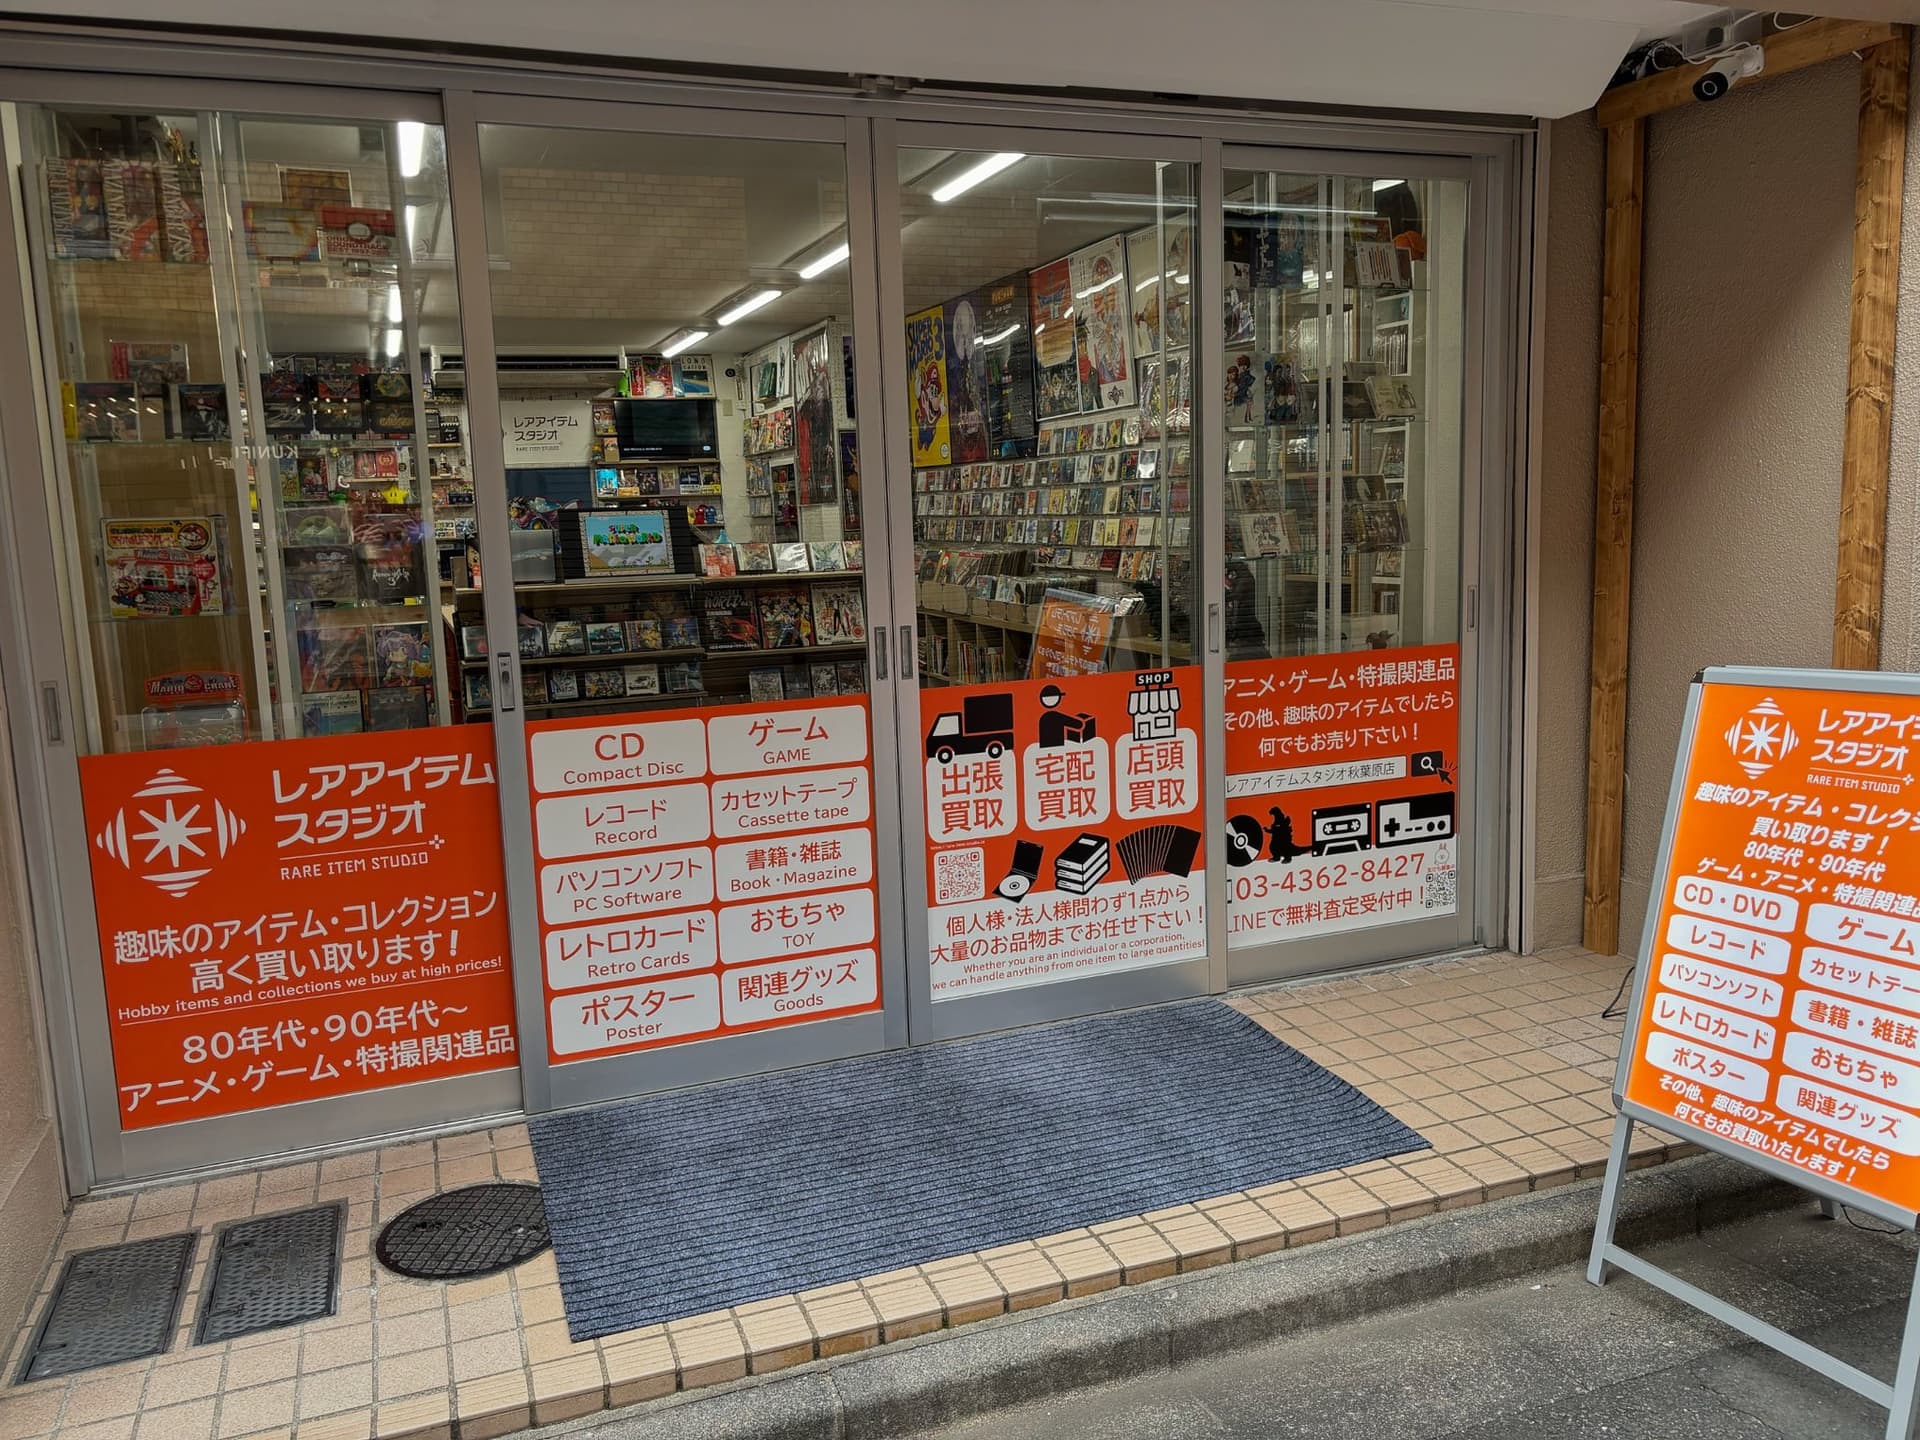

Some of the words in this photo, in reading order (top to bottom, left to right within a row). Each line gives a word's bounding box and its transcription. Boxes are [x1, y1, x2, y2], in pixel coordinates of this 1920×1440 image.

[934, 318, 945, 360] 3
[513, 415, 578, 428] レアアイテム
[514, 430, 558, 442] スタジオ
[1138, 673, 1170, 685] SHOP
[1224, 657, 1455, 697] アニメ・ゲーム・特撮関連品
[1225, 690, 1454, 731] その他、趣味のアイテムでしたら
[594, 732, 645, 761] CD
[748, 716, 829, 747] ゲーム
[1258, 722, 1419, 758] 何でもお売り下さい！
[563, 764, 642, 785] Compact
[647, 761, 684, 775] Disc
[762, 748, 811, 765] GAME
[1034, 749, 1097, 786] 宅配
[1127, 740, 1185, 776] 店頭
[1810, 738, 1909, 771] スタジオ
[272, 753, 496, 804] レアアイテム
[721, 776, 858, 812] カセットテープ
[941, 760, 1004, 798] 出張
[1128, 777, 1186, 813] 買取
[1226, 761, 1395, 794] レアアイテムスタジオ秋葉原店
[1807, 774, 1831, 786] RARE
[1834, 777, 1859, 789] ITEM
[1860, 780, 1901, 794] STUDIO
[584, 799, 668, 828] レコード
[738, 809, 809, 829] Cassette
[813, 804, 849, 822] tape
[941, 798, 1004, 835] 買取
[1038, 786, 1097, 823] 買取
[274, 800, 426, 849] スタジオ
[594, 825, 658, 846] Record
[1749, 816, 1890, 856] 買い取ります！
[281, 863, 322, 881] RARE
[328, 858, 366, 875] ITEM
[372, 851, 429, 871] STUDIO
[746, 839, 842, 871] 書籍・雑誌
[1743, 841, 1886, 884] 80年代・90年代
[556, 857, 703, 895] パソコンソフト
[1236, 853, 1425, 900] 03-4362-8427
[573, 899, 598, 913] PC
[603, 887, 682, 909] Software
[750, 901, 846, 933] おもちゃ
[946, 883, 1190, 937] 個人様・法人様問わず1点から
[1228, 885, 1425, 933] INEで無料査定受付中！
[113, 889, 498, 965] 趣味のアイテム・コレクション
[559, 918, 705, 962] レトロカード
[782, 933, 816, 949] TOY
[930, 905, 1204, 965] 大量のお品物までお任せ下さい！
[1690, 924, 1767, 961] レコード
[1837, 916, 1915, 956] ゲーム
[190, 928, 460, 994] 高く買い取ります！
[587, 960, 636, 978] Retro
[641, 952, 690, 970] Cards
[932, 982, 949, 991] we
[950, 978, 968, 988] can
[970, 970, 1005, 985] handle
[1006, 964, 1050, 980] anything
[1051, 960, 1074, 971] from
[1076, 958, 1094, 967] one
[1095, 953, 1116, 964] item
[1118, 952, 1129, 961] to
[1131, 946, 1155, 960] large
[1156, 939, 1205, 957] quantities!
[963, 960, 1006, 974] Whether
[1008, 957, 1027, 969] you
[1028, 955, 1045, 965] are
[1047, 952, 1059, 961] an
[1061, 944, 1108, 959] individual
[1109, 942, 1119, 951] or
[1121, 941, 1127, 949] a
[118, 1002, 170, 1021] Hobby
[175, 995, 219, 1013] items
[223, 990, 252, 1006] and
[257, 978, 342, 1001] collections
[346, 976, 367, 988] we
[371, 968, 398, 986] buy
[401, 966, 417, 980] at
[420, 959, 452, 978] high
[455, 955, 503, 973] prices!
[737, 959, 859, 1002] 関連グッズ
[1668, 963, 1775, 1006] パソコンソフト
[581, 989, 696, 1027] ポスター
[774, 993, 824, 1013] Goods
[606, 1021, 663, 1042] Poster
[1659, 1000, 1769, 1050] レトロカード
[1807, 1000, 1919, 1050] 書籍・雑誌
[120, 1024, 515, 1112] アニメ・ゲーム・特撮関連品
[1672, 1047, 1746, 1081] ポスター
[1811, 1046, 1899, 1090] おもちゃ
[1658, 1074, 1892, 1171] その他、趣味のアイテムでしたら
[1797, 1087, 1902, 1139] 関連グッズ
[1674, 1102, 1857, 1182] 何でもお買取いたします！
